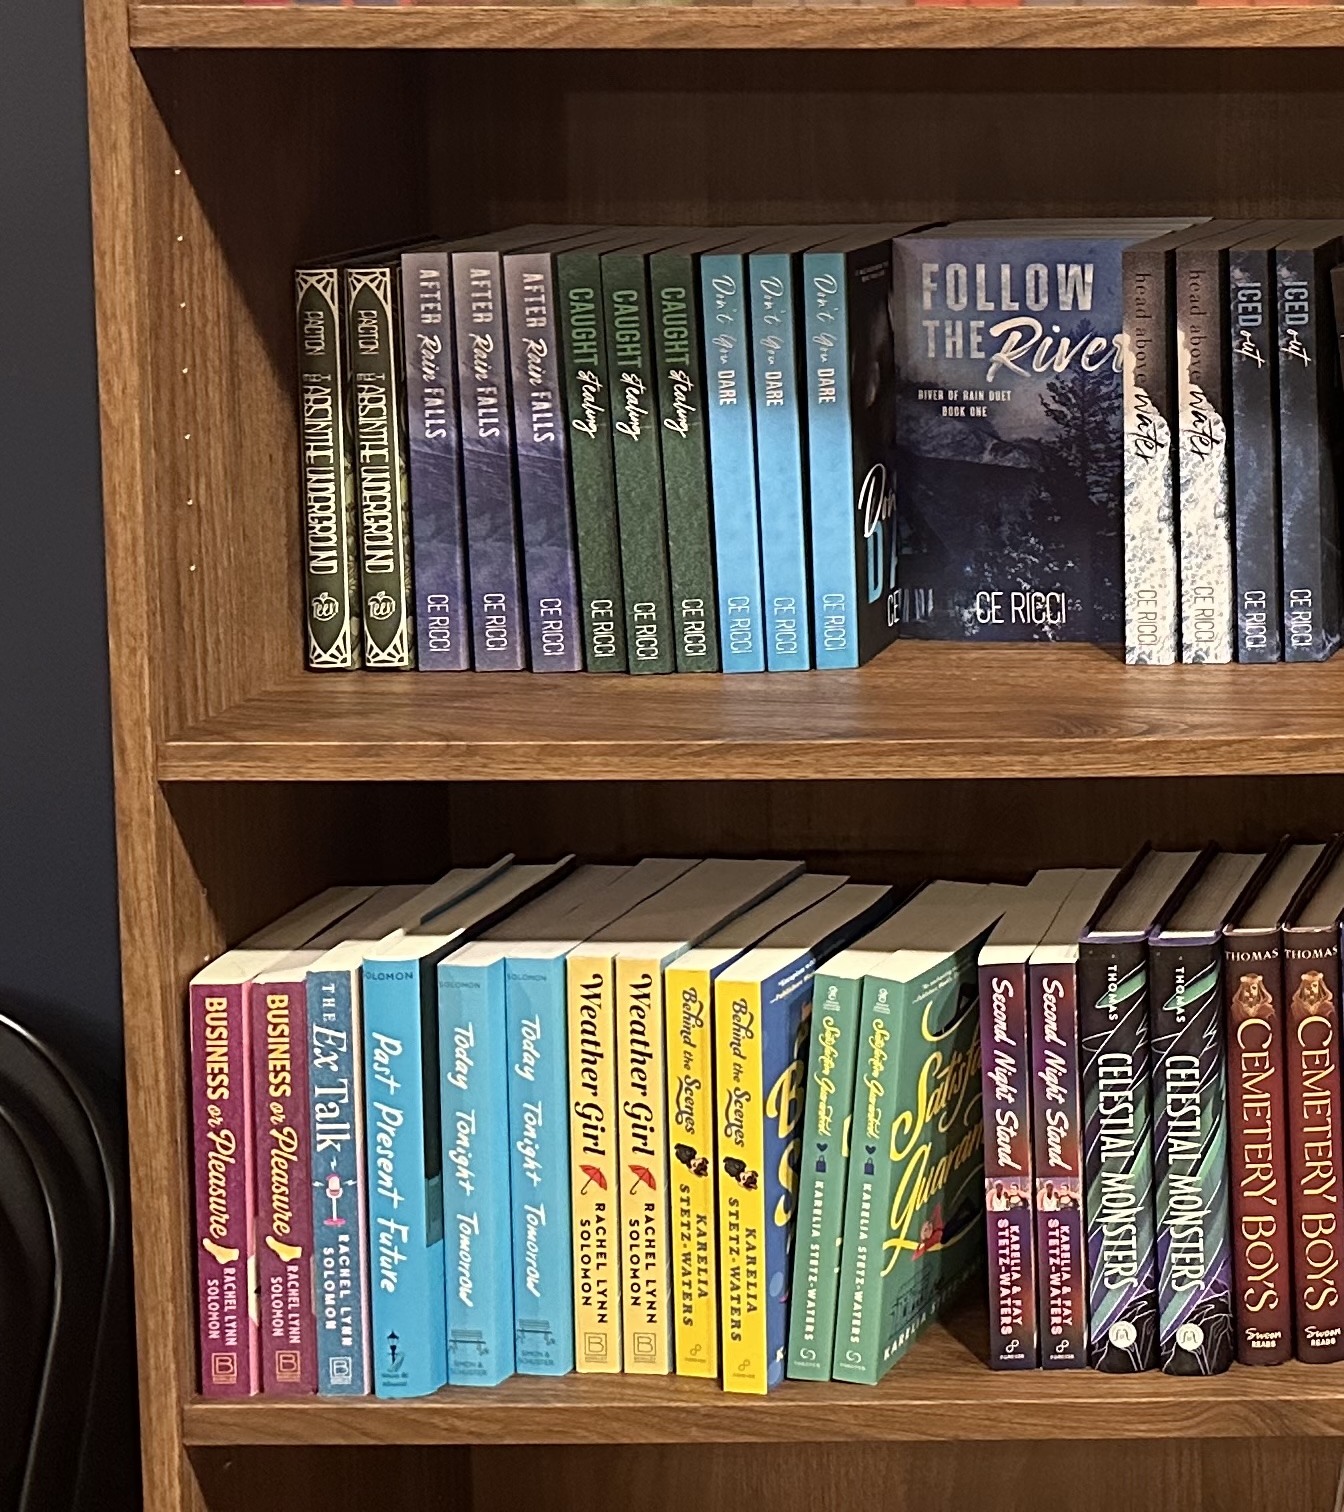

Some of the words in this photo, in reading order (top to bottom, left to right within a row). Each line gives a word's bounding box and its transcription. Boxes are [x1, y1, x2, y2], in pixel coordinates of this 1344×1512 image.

[419, 269, 442, 324] AFTER
[921, 263, 1095, 311] FOLLOW
[417, 333, 442, 382] Rain
[922, 320, 986, 359] THE
[986, 316, 1125, 383] River
[424, 387, 447, 439] FALLS
[918, 389, 944, 401] RIVER
[948, 390, 959, 401] OF
[963, 391, 985, 401] RAIN
[989, 391, 1011, 402] DUET
[942, 406, 965, 417] BOOK
[969, 406, 987, 417] ONE
[976, 591, 1005, 624] CE
[1011, 591, 1066, 624] RICCI
[205, 996, 230, 1100] BUSINESS
[371, 1032, 403, 1095] Past
[579, 973, 604, 1097] Weather
[207, 1104, 224, 1124] or
[574, 1101, 606, 1156] Girl
[1097, 1052, 1135, 1164] CELESTIAL
[1236, 1018, 1278, 1206] CEMETERY
[206, 1130, 237, 1240] Pleasure
[373, 1101, 405, 1209] Present
[379, 1216, 407, 1293] Future
[1096, 1173, 1145, 1290] MONSTERS
[1241, 1215, 1279, 1312] BOYS
